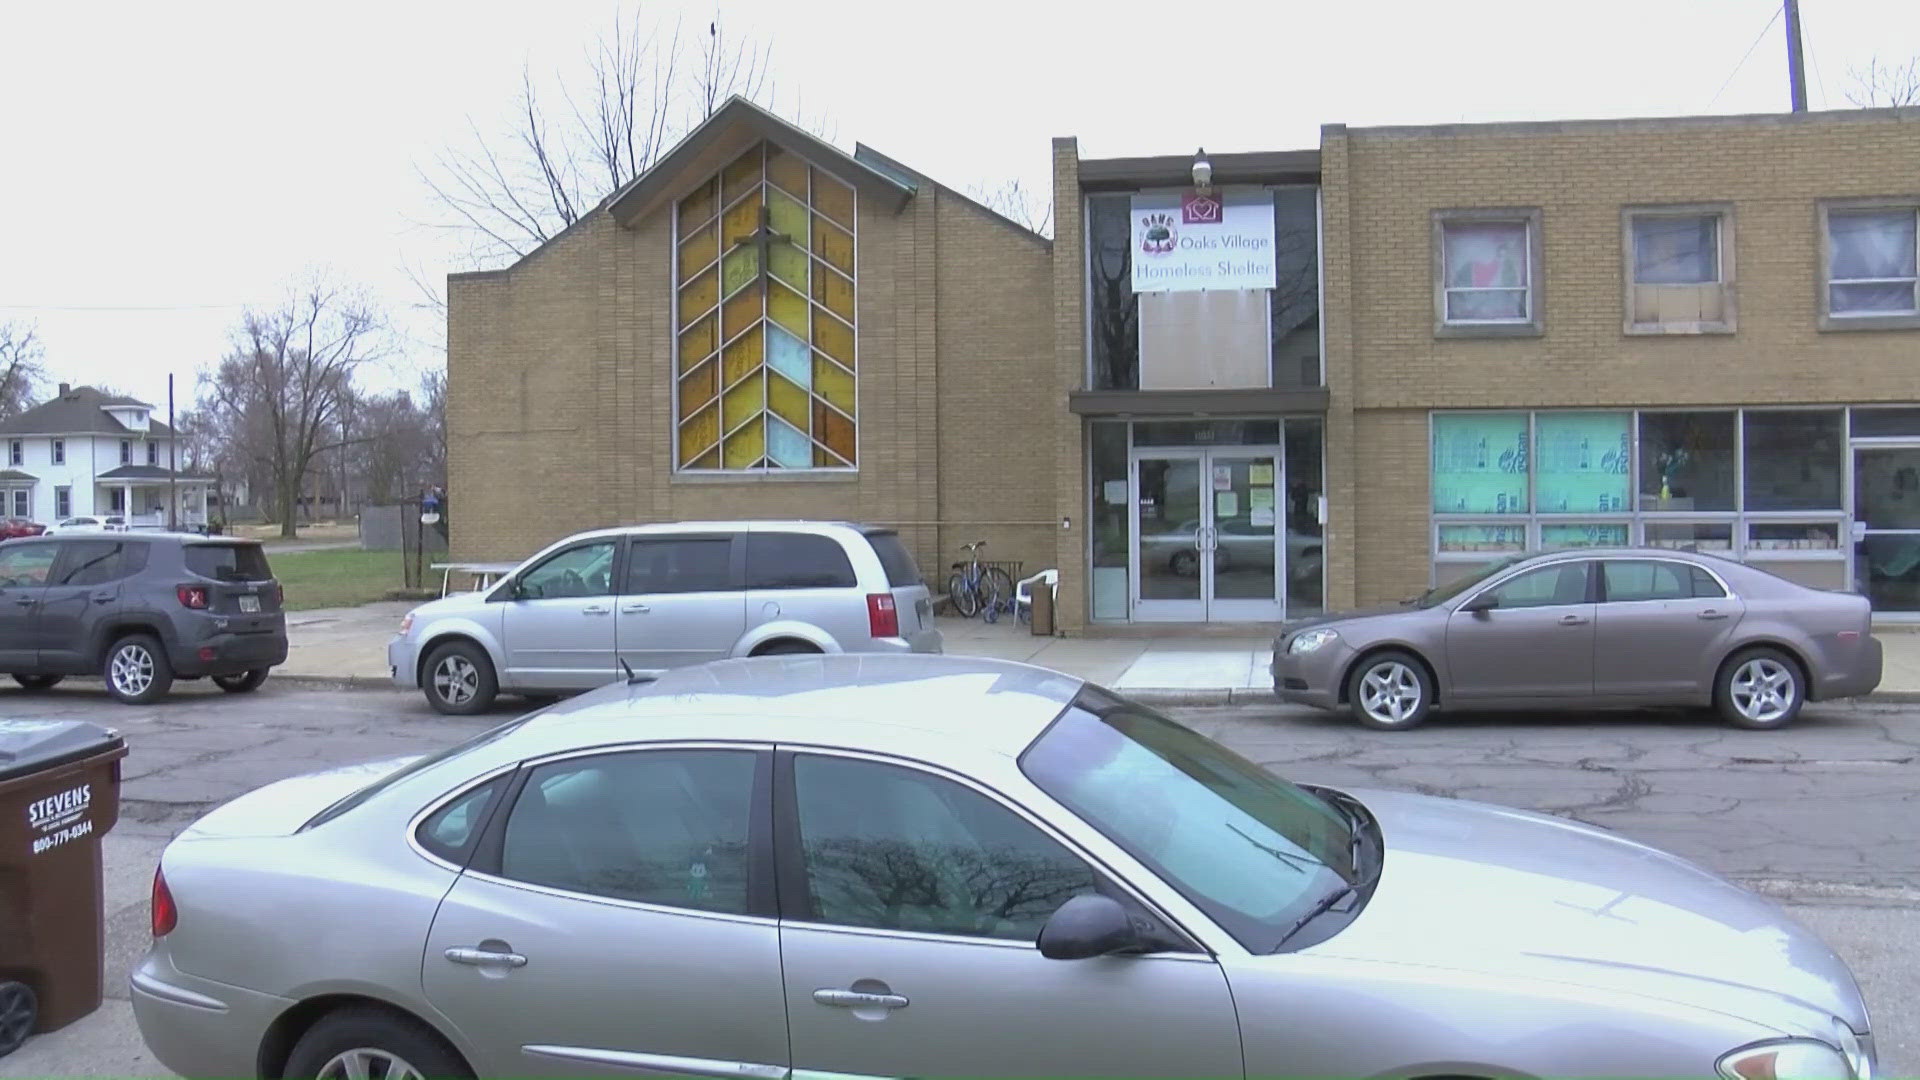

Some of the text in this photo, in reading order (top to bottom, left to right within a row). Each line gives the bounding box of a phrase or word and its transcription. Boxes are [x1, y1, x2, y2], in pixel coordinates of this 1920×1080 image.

[1180, 233, 1268, 250] Oaks Village
[1136, 260, 1270, 279] Homeless Shelter
[29, 784, 91, 822] STEVENS
[33, 819, 93, 854] 800-779-0344
